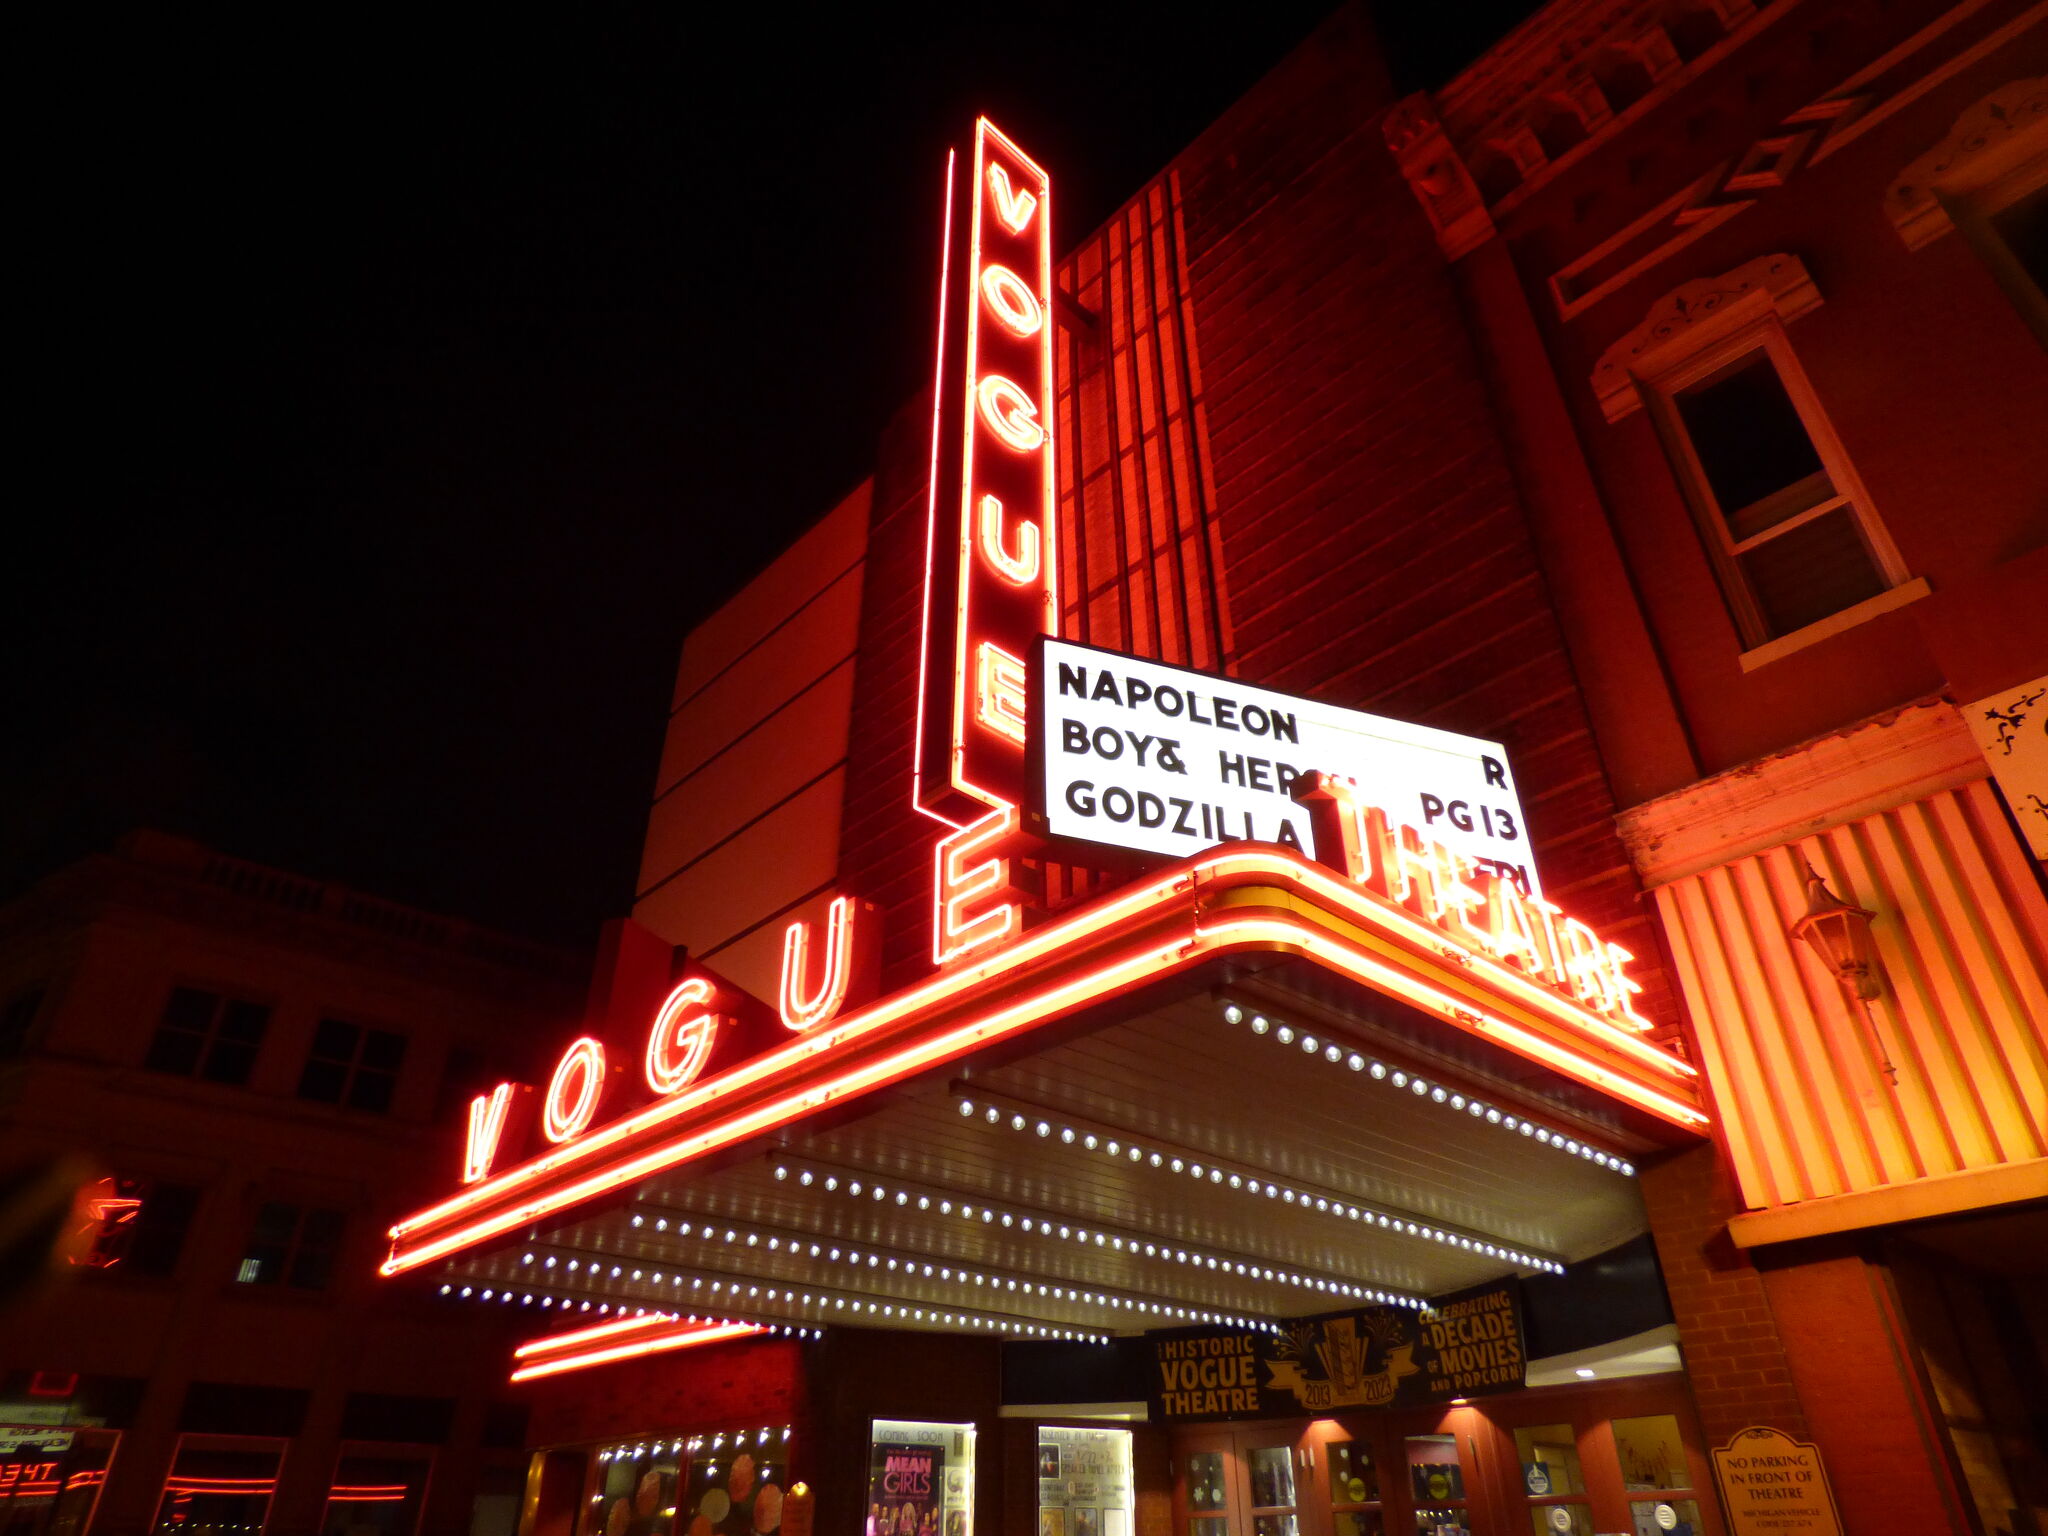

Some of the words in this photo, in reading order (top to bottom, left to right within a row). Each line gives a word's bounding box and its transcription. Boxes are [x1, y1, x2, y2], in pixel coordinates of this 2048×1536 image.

[978, 160, 1046, 746] VOGUE
[1058, 662, 1300, 744] NAPOLEON
[1062, 718, 1188, 775] BOY&
[1219, 750, 1320, 796] HER
[1482, 754, 1508, 791] R
[1065, 779, 1305, 852] GODZILLA
[1313, 769, 1654, 1032] THEATRE
[463, 804, 1016, 1183] VOGUE
[1418, 1290, 1512, 1325] CELEBRATING
[1421, 1332, 1431, 1346] A
[1430, 1309, 1517, 1350] DECADE
[1165, 1335, 1255, 1359] HISTORIC
[1439, 1337, 1521, 1375] MOVIES
[1160, 1355, 1257, 1391] VOGUE
[1364, 1374, 1393, 1401] 2023
[1431, 1378, 1450, 1392] AND
[1160, 1387, 1260, 1415] THEATRE
[1305, 1383, 1331, 1405] 2013
[916, 1431, 944, 1443] SOON
[885, 1456, 932, 1472] MEAN
[1728, 1457, 1748, 1469] NO
[1751, 1455, 1808, 1468] PARKING
[1730, 1473, 1745, 1484] IN
[1749, 1471, 1791, 1484] FRONT
[1796, 1471, 1814, 1482] OF
[883, 1471, 931, 1494] GIRLS
[1747, 1488, 1803, 1500] THEATRE
